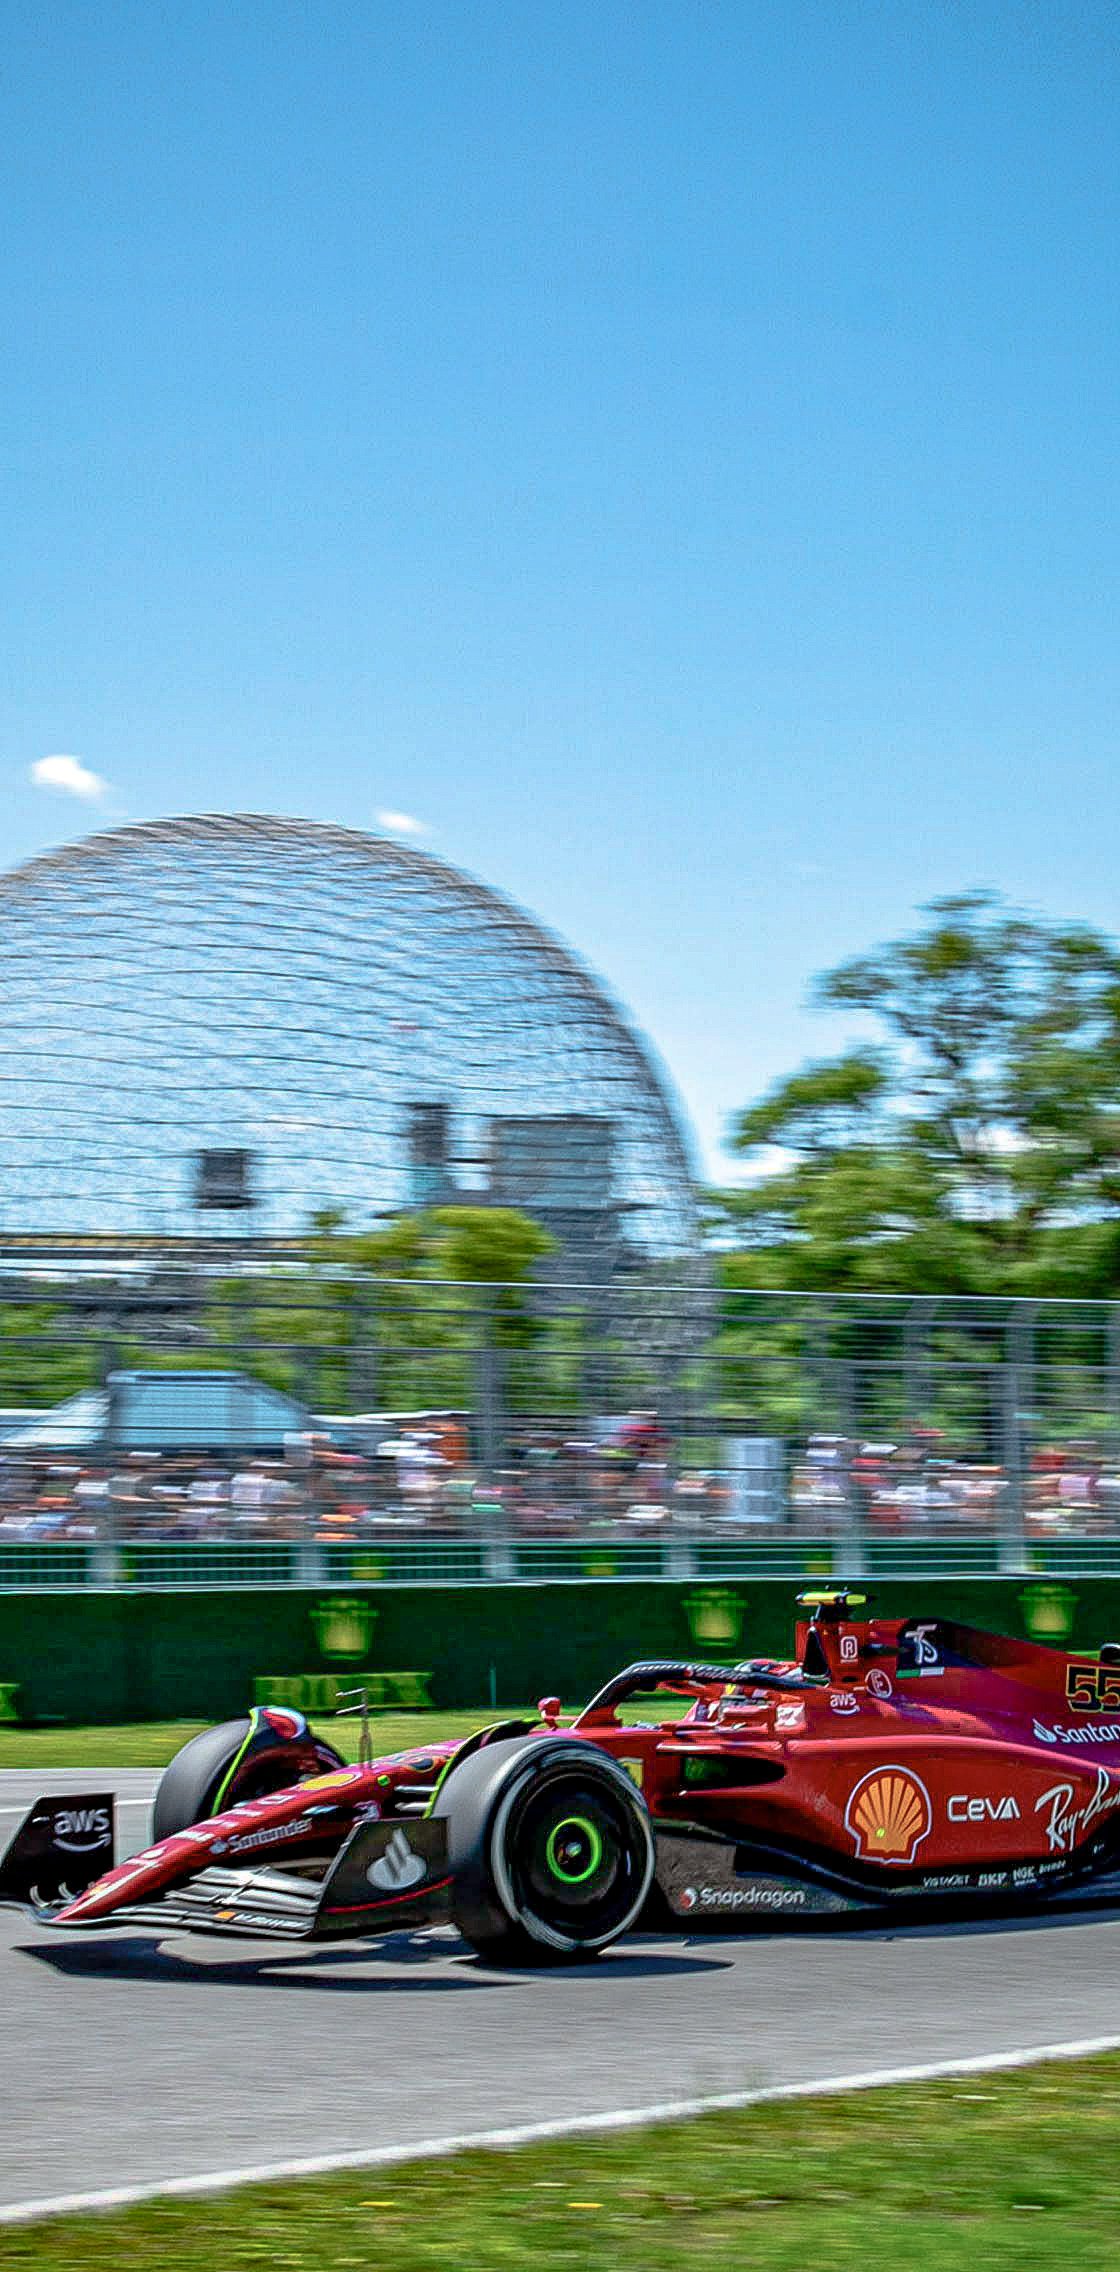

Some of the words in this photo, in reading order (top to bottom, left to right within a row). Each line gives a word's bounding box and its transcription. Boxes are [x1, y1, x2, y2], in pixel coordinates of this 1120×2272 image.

[830, 1692, 856, 1707] aws
[1065, 1663, 1120, 1714] 55
[53, 1808, 110, 1835] aws
[700, 1885, 806, 1910] Snapdragon
